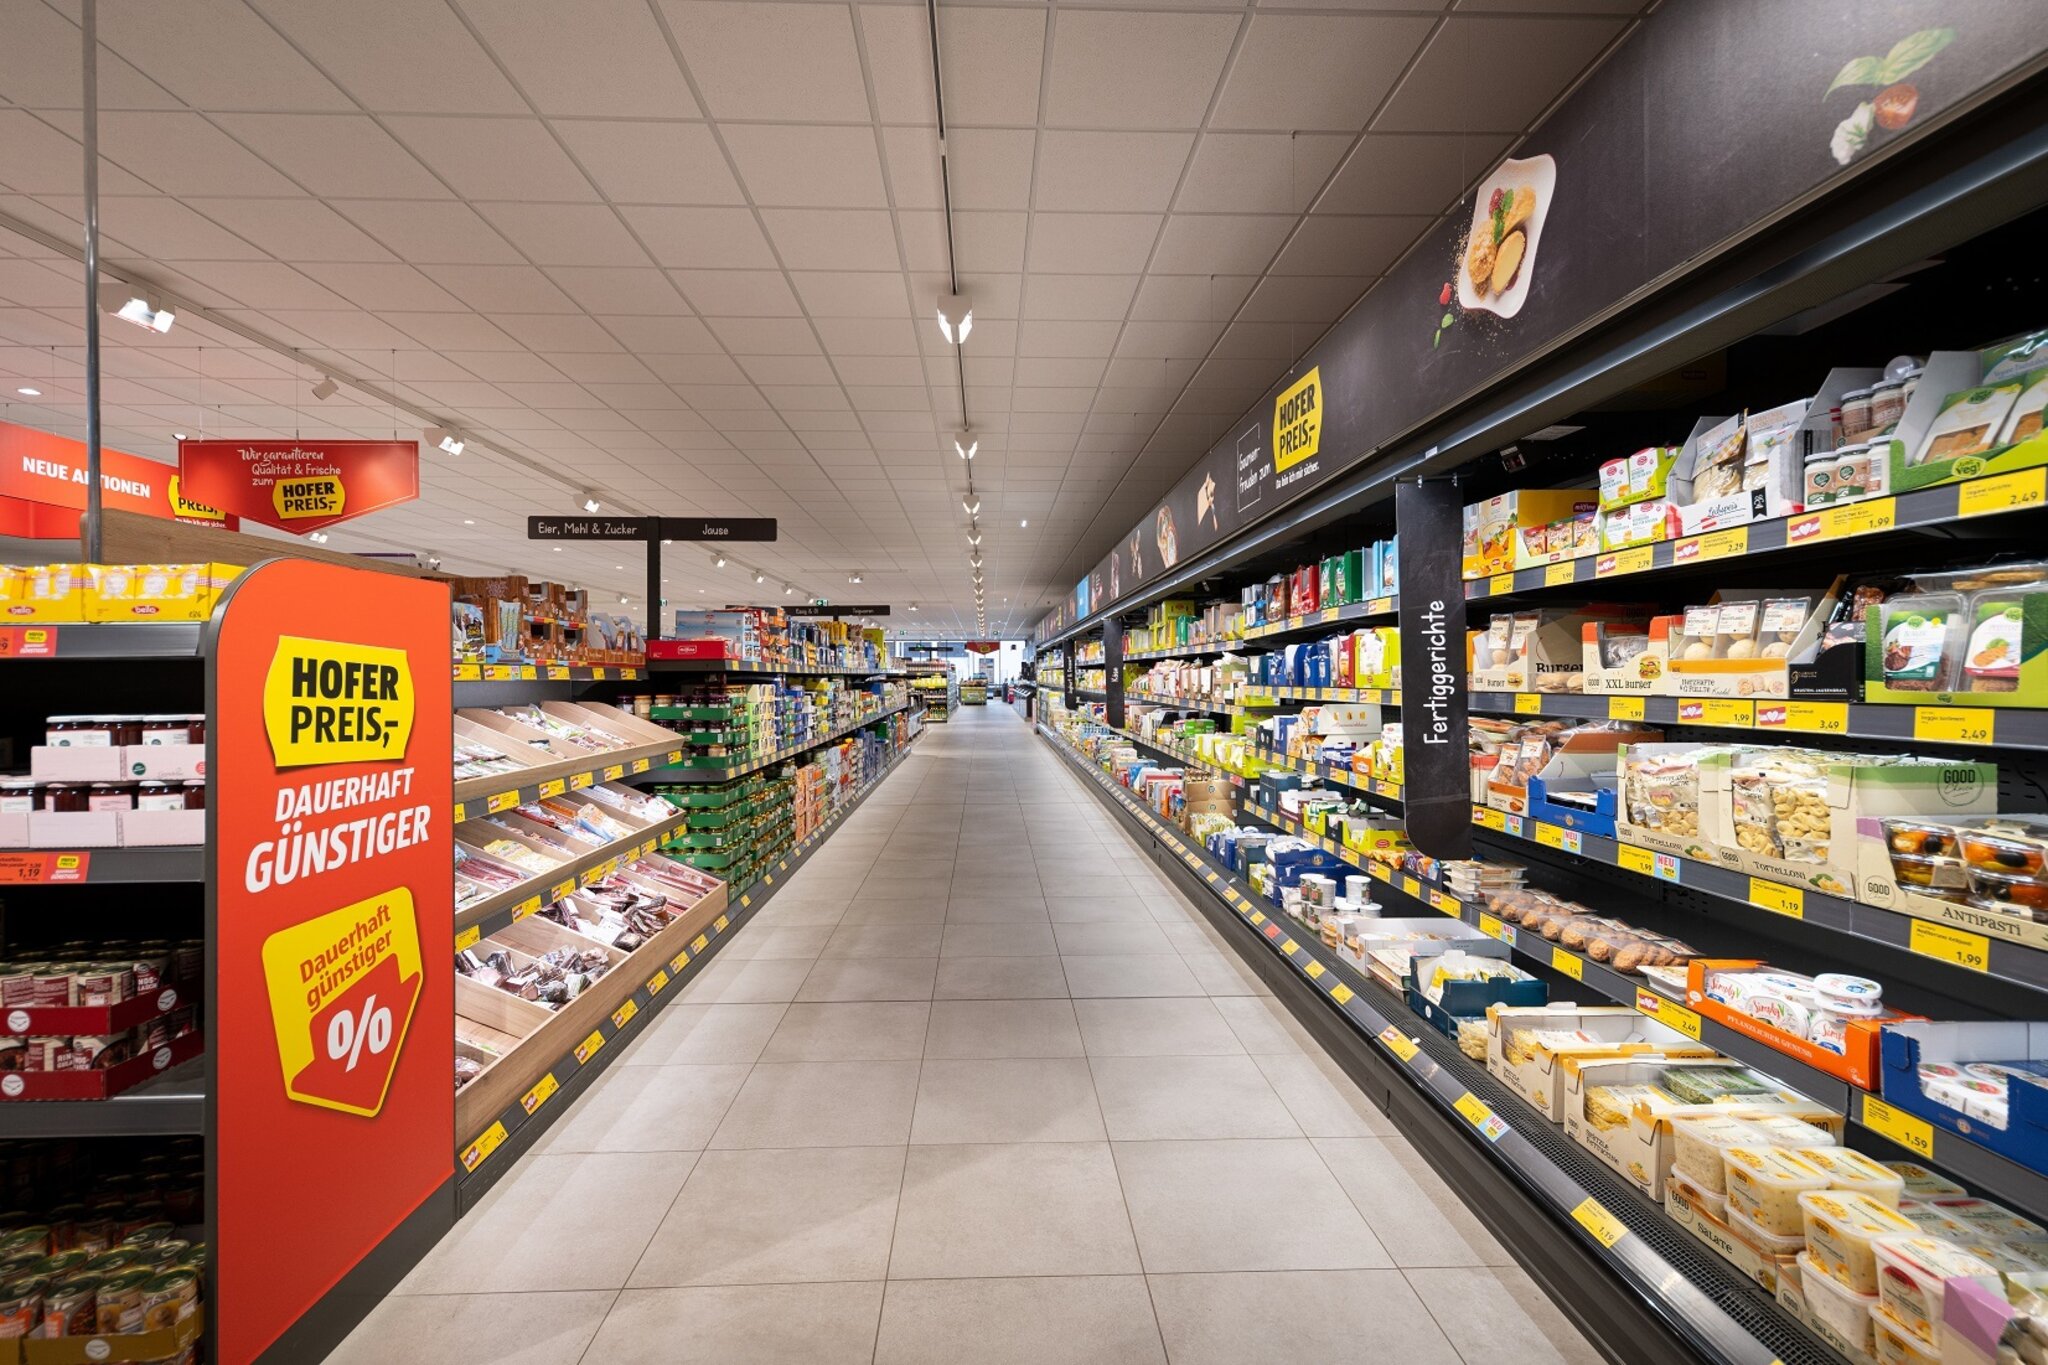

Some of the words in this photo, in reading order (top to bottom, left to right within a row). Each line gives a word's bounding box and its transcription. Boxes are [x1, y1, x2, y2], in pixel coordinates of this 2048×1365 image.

[1280, 383, 1315, 431] HOFER
[1280, 419, 1316, 459] PREIS,-
[237, 447, 259, 460] Wir
[264, 447, 324, 466] garantieren
[22, 456, 69, 481] NEUE
[72, 468, 150, 498] AIONEN
[252, 464, 291, 476] Qualität
[295, 464, 302, 475] &
[306, 464, 341, 475] Frische
[1259, 462, 1271, 481] zum
[252, 478, 273, 487] zum
[283, 482, 335, 498] HOFER
[284, 497, 337, 512] PREIS,-
[538, 523, 560, 536] Eier,
[564, 523, 588, 534] Mehl
[592, 523, 600, 534] &
[605, 523, 637, 535] Zucker
[703, 523, 729, 535] Jause
[292, 657, 399, 701] HOFER
[1421, 600, 1455, 745] Fertiggerichte
[1605, 680, 1623, 689] XXL
[1734, 713, 1750, 722] 1,99
[1819, 720, 1839, 729] 3,49
[291, 705, 399, 748] PREIS,-
[1961, 728, 1987, 740] 2,49
[1944, 769, 1976, 784] GOOD
[275, 767, 415, 823] DAUERHAFT
[245, 805, 432, 894] GÜNSTIGER
[1658, 855, 1675, 868] NEU
[18, 868, 40, 878] 1,19
[1868, 881, 1890, 896] GOOD
[1781, 900, 1798, 911] 1,19
[300, 904, 391, 984] Dauerhaft
[1956, 951, 1982, 965] 1,99
[307, 930, 393, 1013] günstiger
[327, 994, 392, 1073] %
[1905, 1132, 1928, 1149] 1,59
